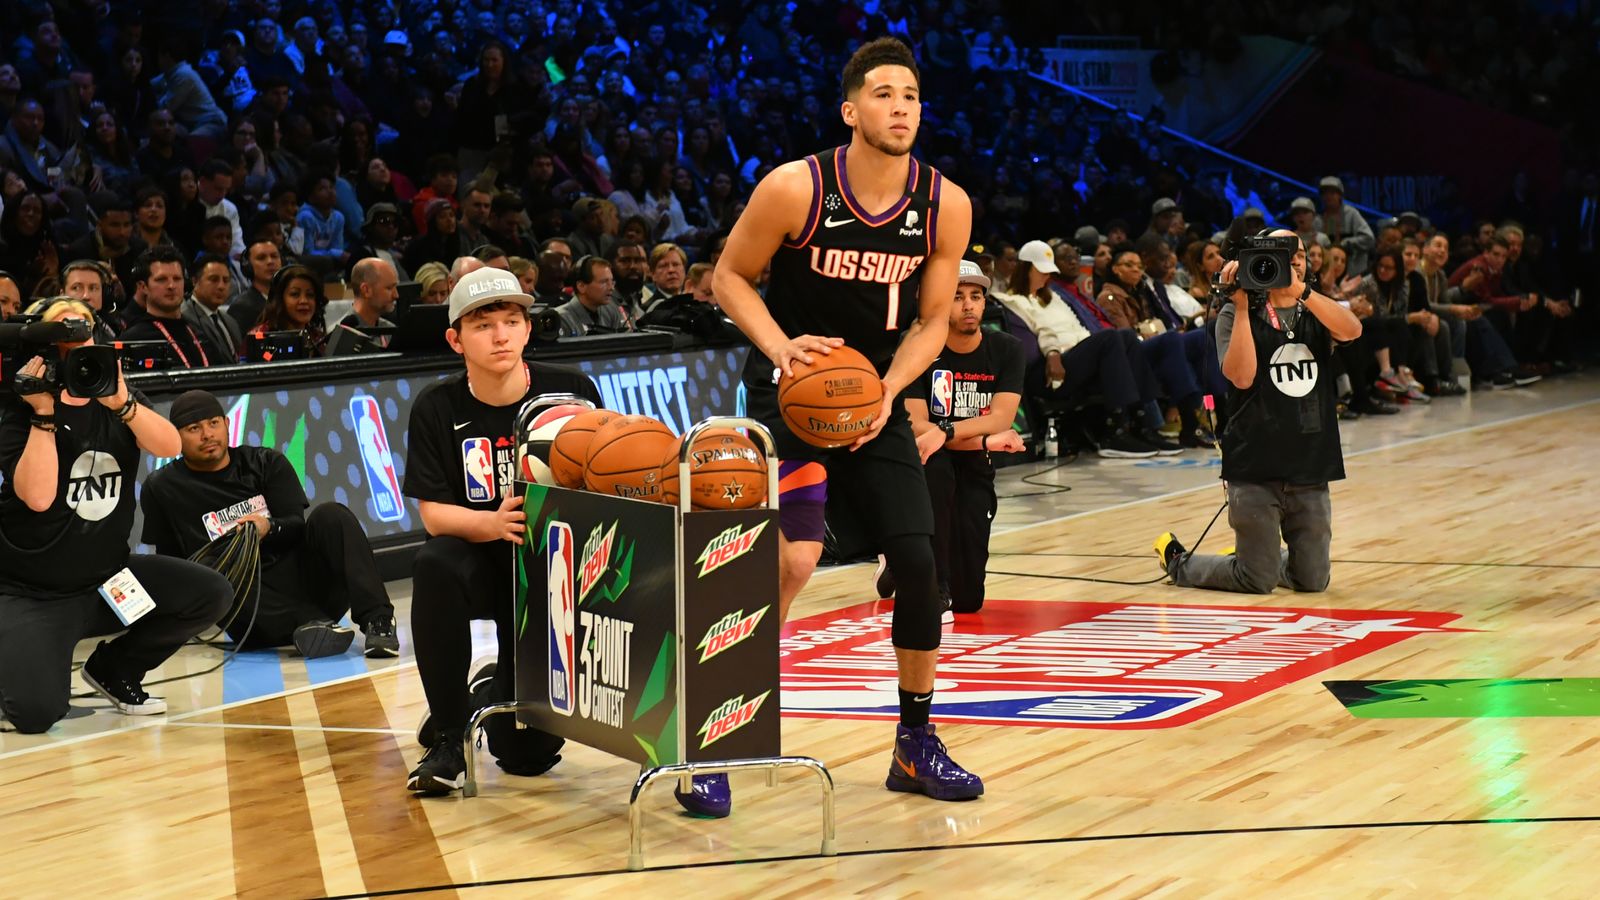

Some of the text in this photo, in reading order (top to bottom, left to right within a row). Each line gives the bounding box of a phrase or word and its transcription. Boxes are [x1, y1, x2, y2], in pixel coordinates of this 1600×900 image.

[899, 228, 923, 237] PayPal
[809, 245, 860, 281] LOS
[886, 282, 899, 331] 1
[1269, 359, 1318, 383] TNT
[954, 391, 993, 409] SATURDA
[69, 471, 122, 502] TNT
[614, 484, 659, 498] SPALD
[376, 492, 394, 514] NBA
[552, 668, 566, 701] NBA
[592, 683, 626, 729] CONTEST
